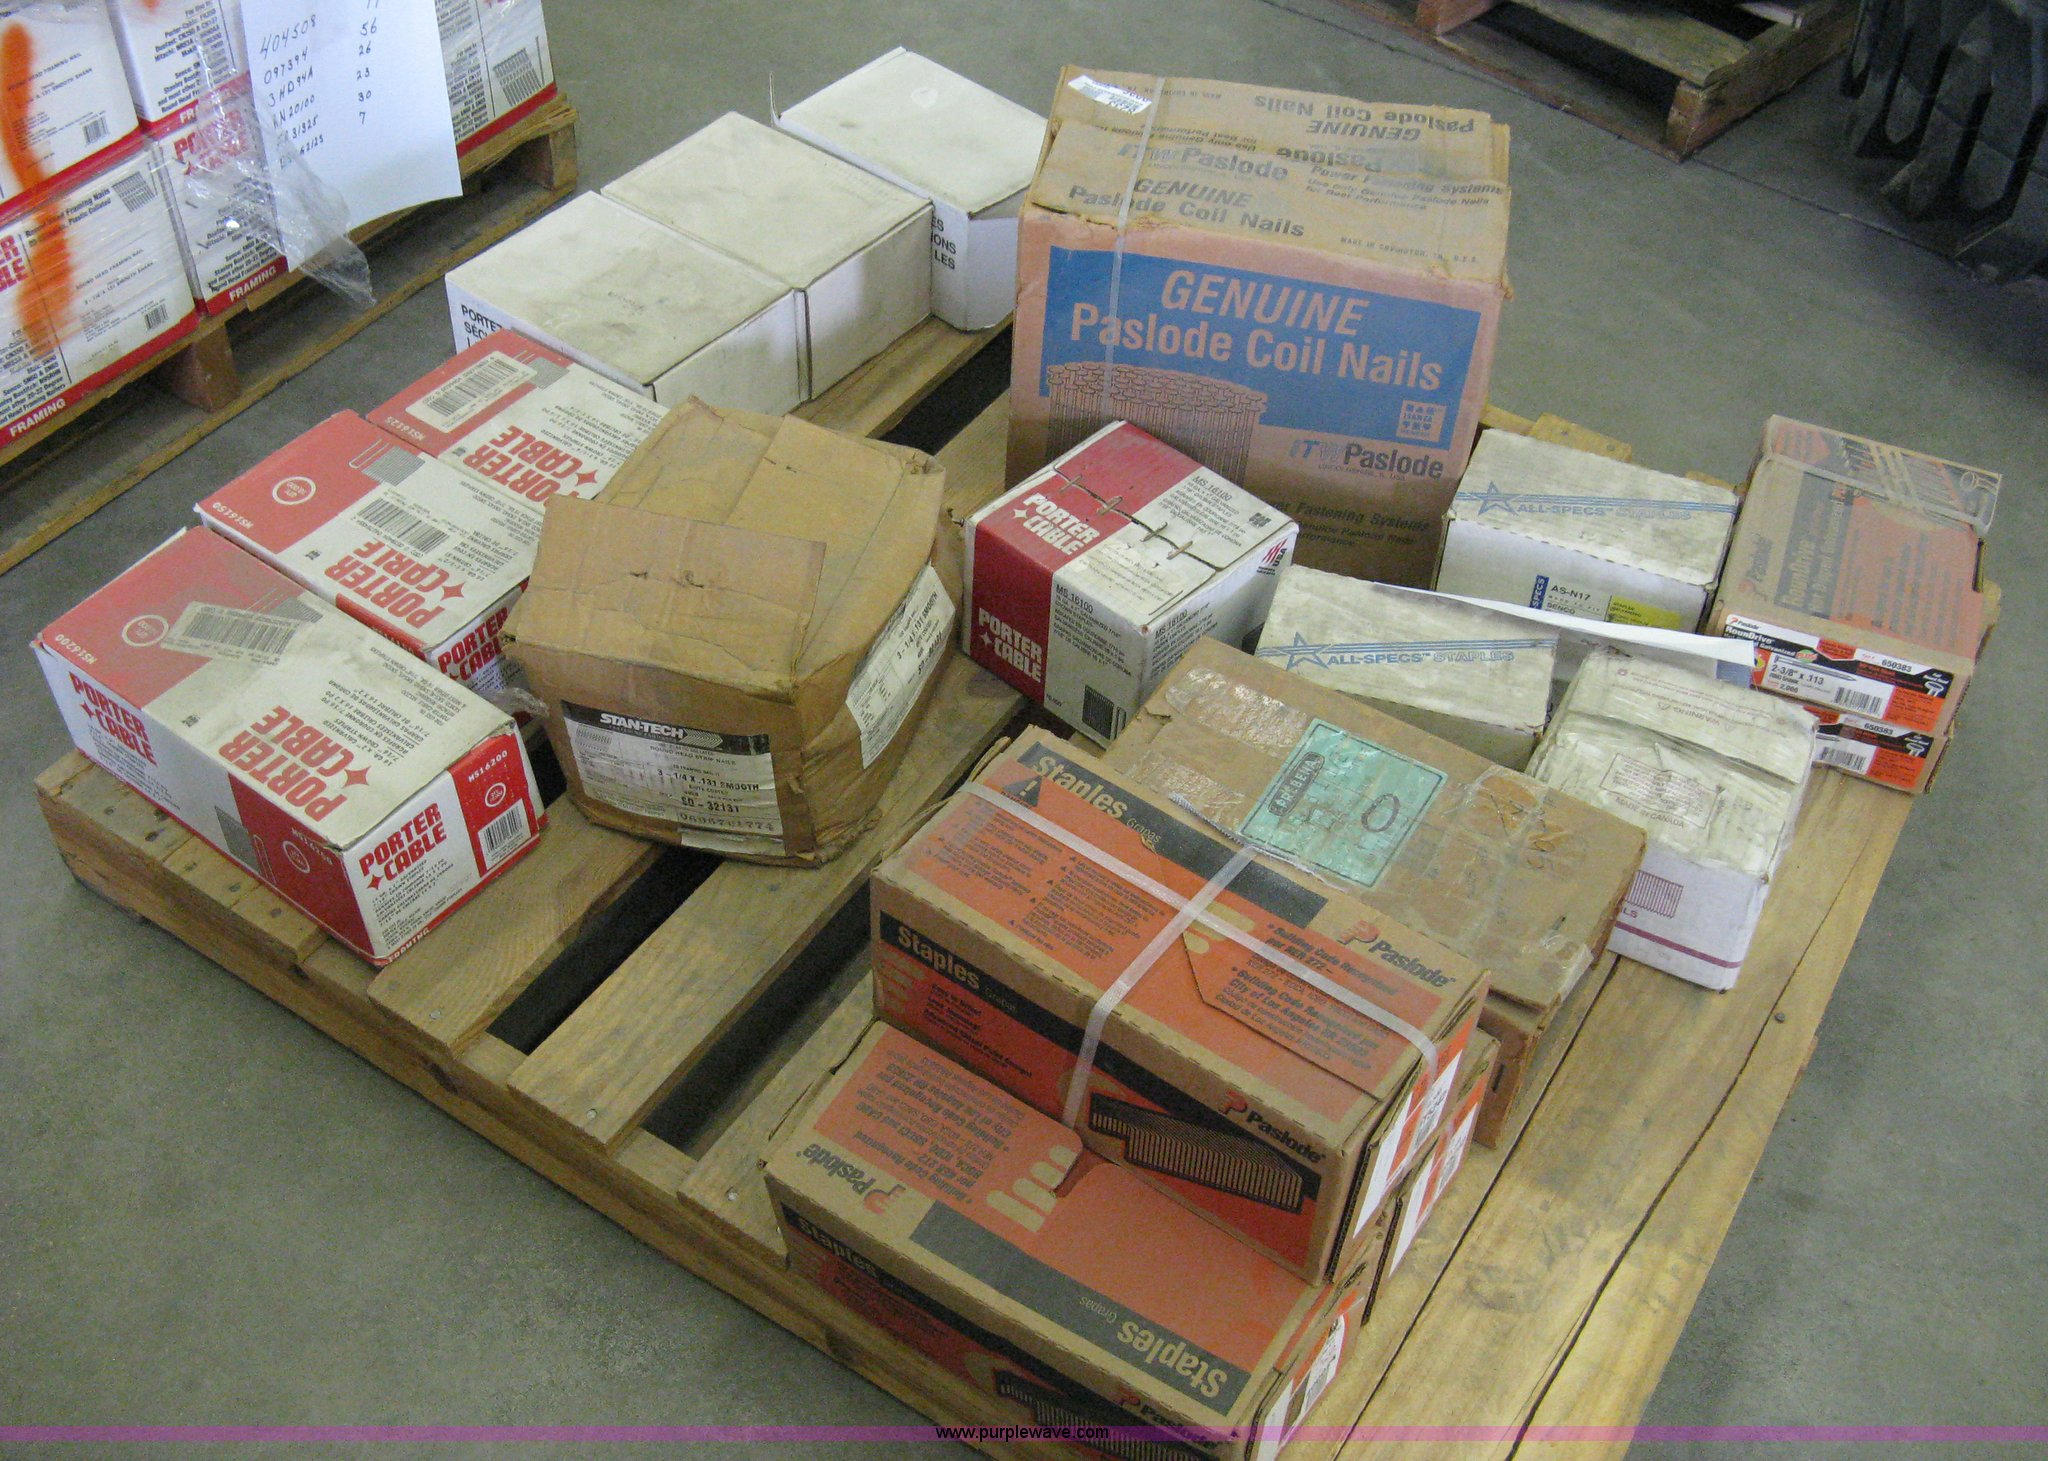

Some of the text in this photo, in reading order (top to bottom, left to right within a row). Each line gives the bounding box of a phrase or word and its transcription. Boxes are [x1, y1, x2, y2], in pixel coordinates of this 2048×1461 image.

[261, 14, 316, 59] 404508
[360, 17, 378, 36] 56
[358, 40, 372, 56] 26
[1255, 94, 1475, 133] Paslode Coil Nails
[1307, 118, 1422, 140] GENUINE
[1181, 145, 1289, 182] Paslode
[1312, 165, 1357, 182] Power
[1134, 178, 1253, 207] GENUINE
[1179, 201, 1227, 223] Coil
[1240, 212, 1304, 237] Nails
[229, 266, 277, 301] FRAMING
[1161, 269, 1370, 337] GENUINE
[1071, 303, 1443, 392] Paslode Coil Nails
[9, 398, 66, 437] FRAMING
[490, 425, 583, 479] CABLE
[1343, 443, 1444, 479] Paslode
[462, 443, 580, 501] ORTER
[212, 503, 254, 528] MS16150
[1023, 492, 1101, 543] PORTER
[1299, 501, 1364, 522] Fastening
[1616, 506, 1691, 521] STAPLES
[1022, 515, 1085, 555] CABLE
[324, 555, 446, 628] PORTER
[1551, 584, 1590, 602] AS-N17
[55, 633, 98, 664] MS16200
[437, 608, 508, 673] PORTER
[979, 607, 1042, 658] PORTER
[1736, 619, 1913, 673] Paslode 650383
[1758, 642, 1796, 657] Galvanized
[456, 634, 503, 682] CABL
[994, 640, 1042, 682] CABLE
[1432, 649, 1515, 664] STAPLES
[1769, 663, 1798, 678] 2-3/8"
[1805, 673, 1824, 685] .113
[68, 671, 148, 738] PORTER
[343, 711, 376, 732] COURONNE
[100, 708, 154, 760] CABLE
[250, 706, 355, 777] CABLE
[320, 719, 359, 744] GALVANIZED
[332, 717, 360, 736] STAPLES
[356, 733, 380, 749] CROWN
[399, 724, 427, 742] GRAPAS
[600, 711, 685, 741] STAN-TECH
[1863, 722, 1893, 736] 650383
[380, 734, 411, 755] AGRAFES
[218, 730, 348, 822] PORTER
[673, 771, 687, 782] 1/4
[689, 775, 696, 783] X
[697, 775, 717, 788] .131
[718, 775, 761, 797] SMOOTH
[1032, 756, 1128, 820] Staples
[358, 803, 442, 876] PORTER
[1126, 817, 1161, 844] Grapas
[384, 825, 447, 881] CABLE
[898, 926, 980, 989] Staples
[1078, 1295, 1117, 1323] Grapas
[1116, 1320, 1228, 1398] Staples
